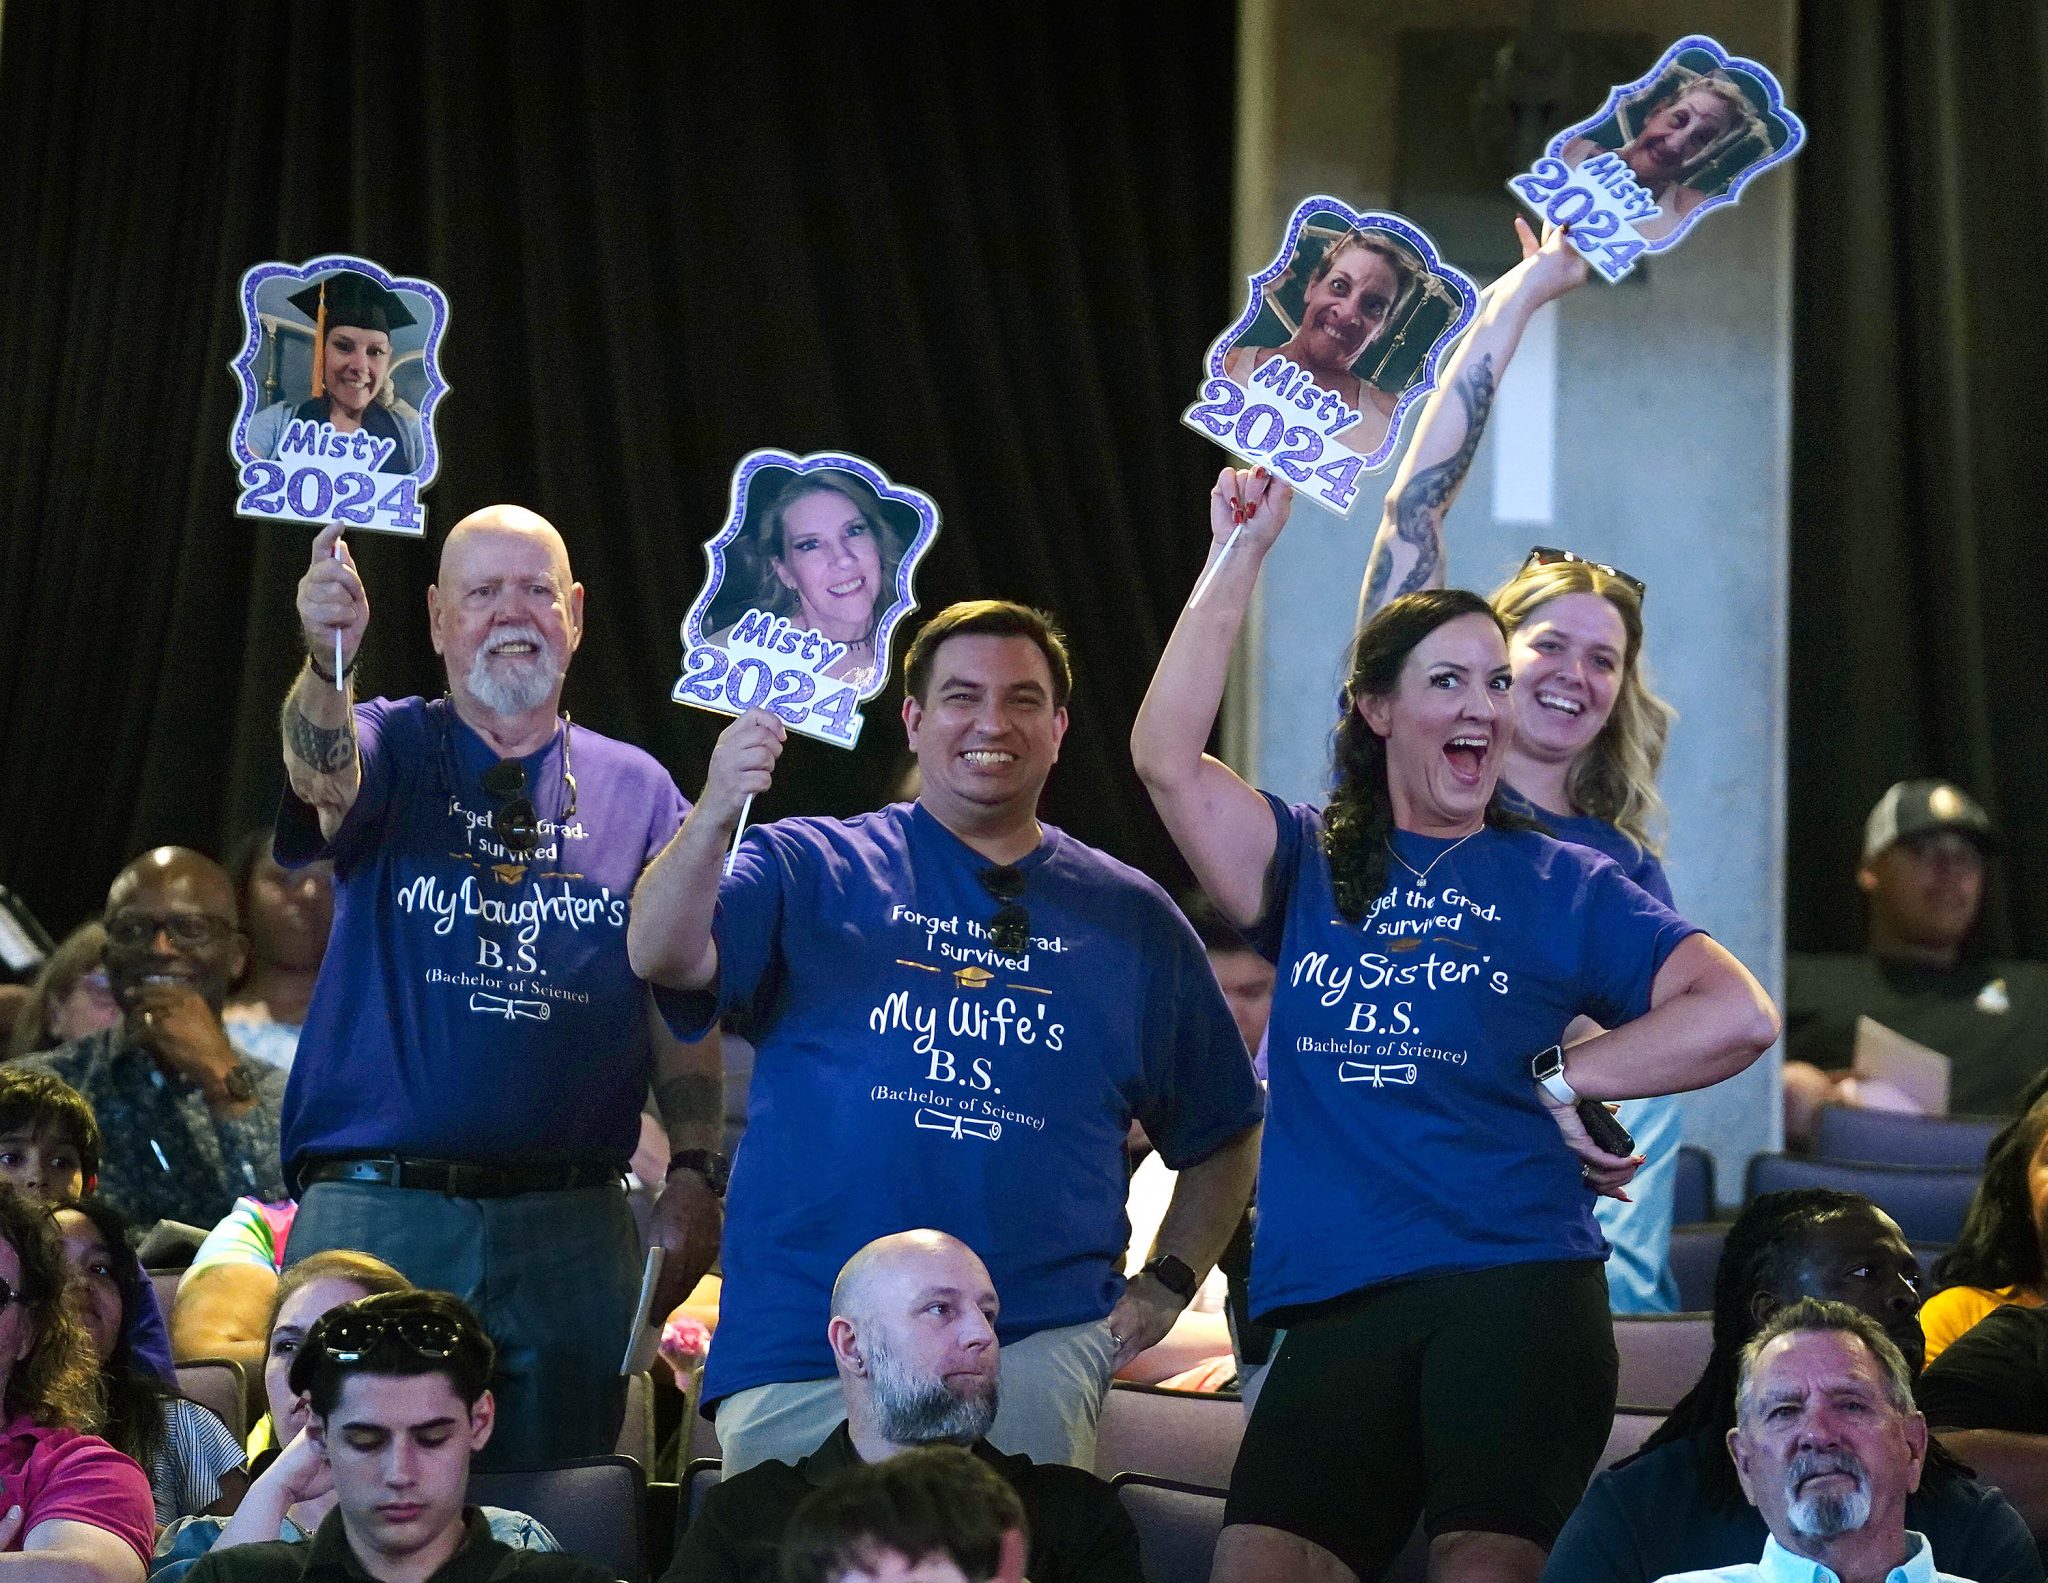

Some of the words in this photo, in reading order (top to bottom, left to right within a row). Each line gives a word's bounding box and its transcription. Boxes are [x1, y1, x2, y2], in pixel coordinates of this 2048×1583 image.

[1583, 154, 1659, 221] Misty
[1514, 158, 1647, 278] 2024
[1253, 358, 1359, 436] Misty
[281, 421, 392, 472] Misty
[1189, 379, 1364, 509] 2024
[241, 462, 421, 529] 2024
[731, 612, 844, 673] Misty
[679, 647, 859, 740] 2024
[467, 829, 472, 846] I
[536, 818, 590, 839] Grad-
[397, 875, 457, 935] My
[459, 875, 625, 944] Daughter's
[892, 904, 959, 935] Forget
[1029, 936, 1069, 953] rad-
[1362, 918, 1372, 932] I
[1376, 912, 1463, 936] survived
[1406, 890, 1436, 909] the
[1442, 888, 1502, 922] Grad-
[476, 935, 548, 976] B.S.
[927, 934, 933, 951] I
[940, 941, 1030, 972] survived
[425, 968, 503, 988] (Bachelor
[508, 979, 526, 993] of
[531, 981, 590, 1004] Science)
[1290, 951, 1353, 1007] My
[1359, 952, 1509, 995] Sister's
[869, 990, 937, 1054] My
[948, 996, 1065, 1051] Wife's
[1345, 1001, 1420, 1035] B.S.
[925, 1048, 1001, 1094] B.S.
[1296, 1036, 1371, 1055] (Bachelor
[1376, 1041, 1395, 1056] of
[1398, 1041, 1468, 1066] Science)
[870, 1085, 953, 1107] (Bachelor
[959, 1098, 978, 1112] of
[982, 1100, 1045, 1132] Science)
